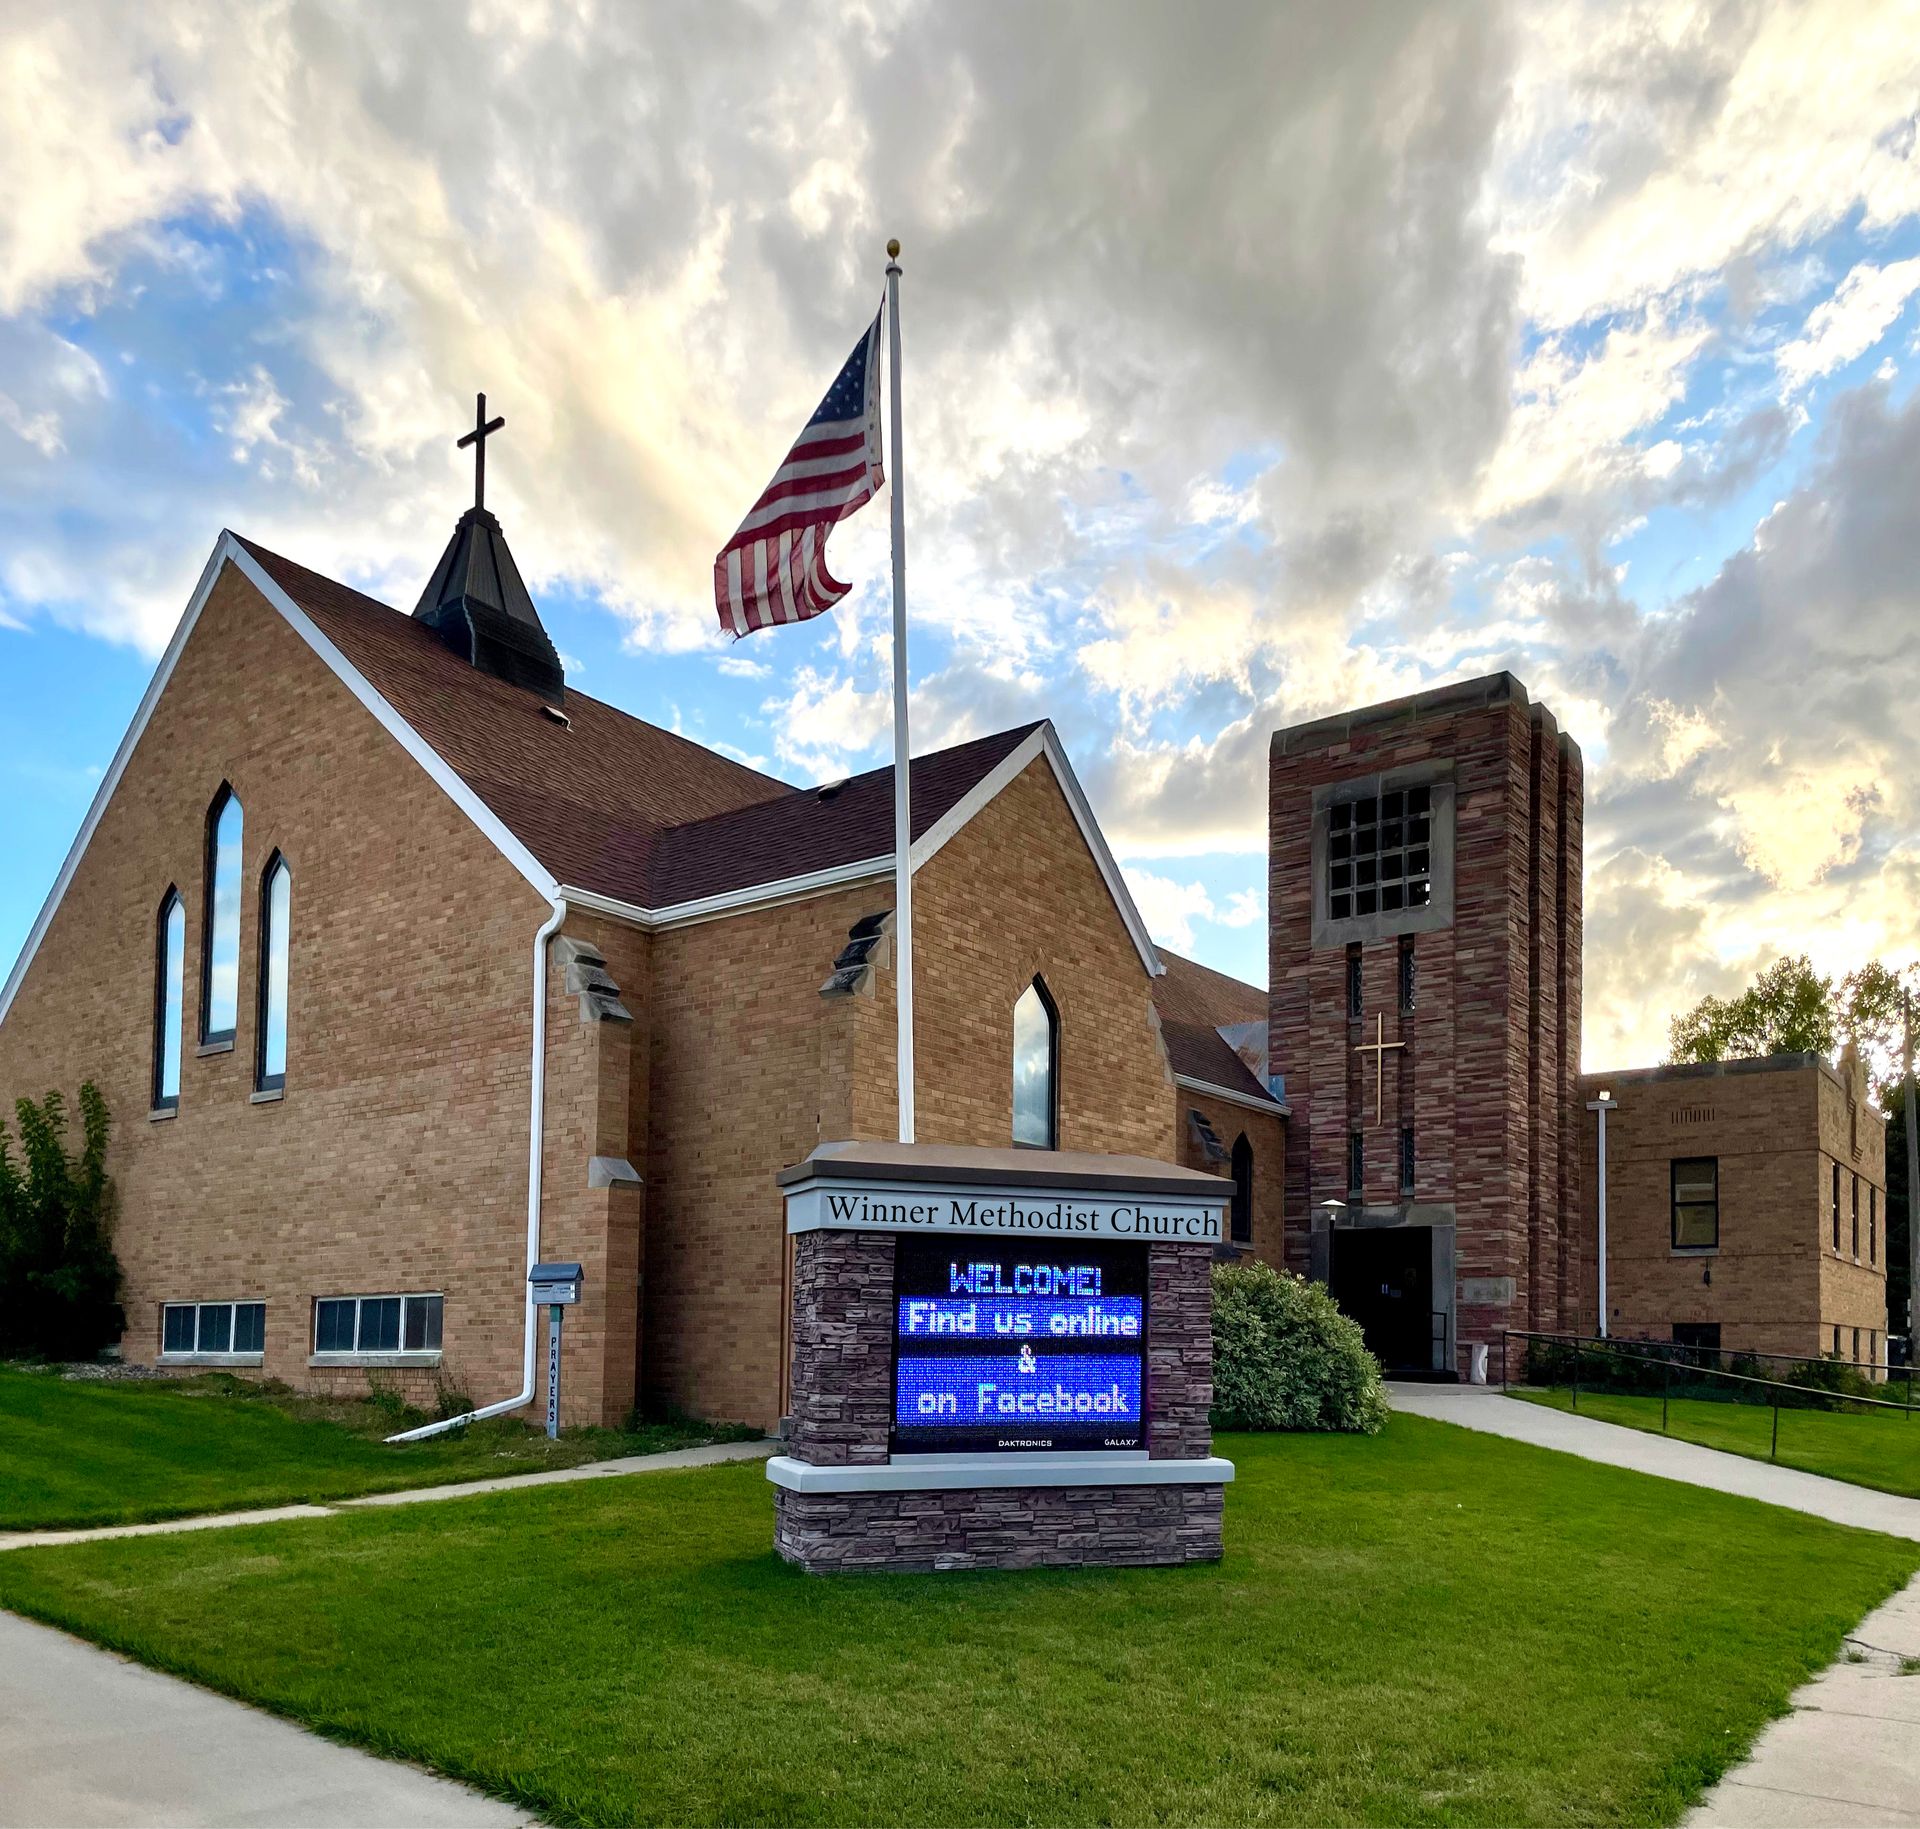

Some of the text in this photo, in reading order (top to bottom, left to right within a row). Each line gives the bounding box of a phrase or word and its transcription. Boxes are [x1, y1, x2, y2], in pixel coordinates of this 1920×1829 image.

[827, 1195, 1219, 1237] Winner Methodist Church
[950, 1263, 1102, 1295] WELCOME!
[908, 1302, 1138, 1336] Find us online
[1018, 1344, 1036, 1374] &
[549, 1336, 557, 1423] PRAYERS
[917, 1383, 1130, 1414] on Facebook
[1104, 1438, 1137, 1446] GALAXY
